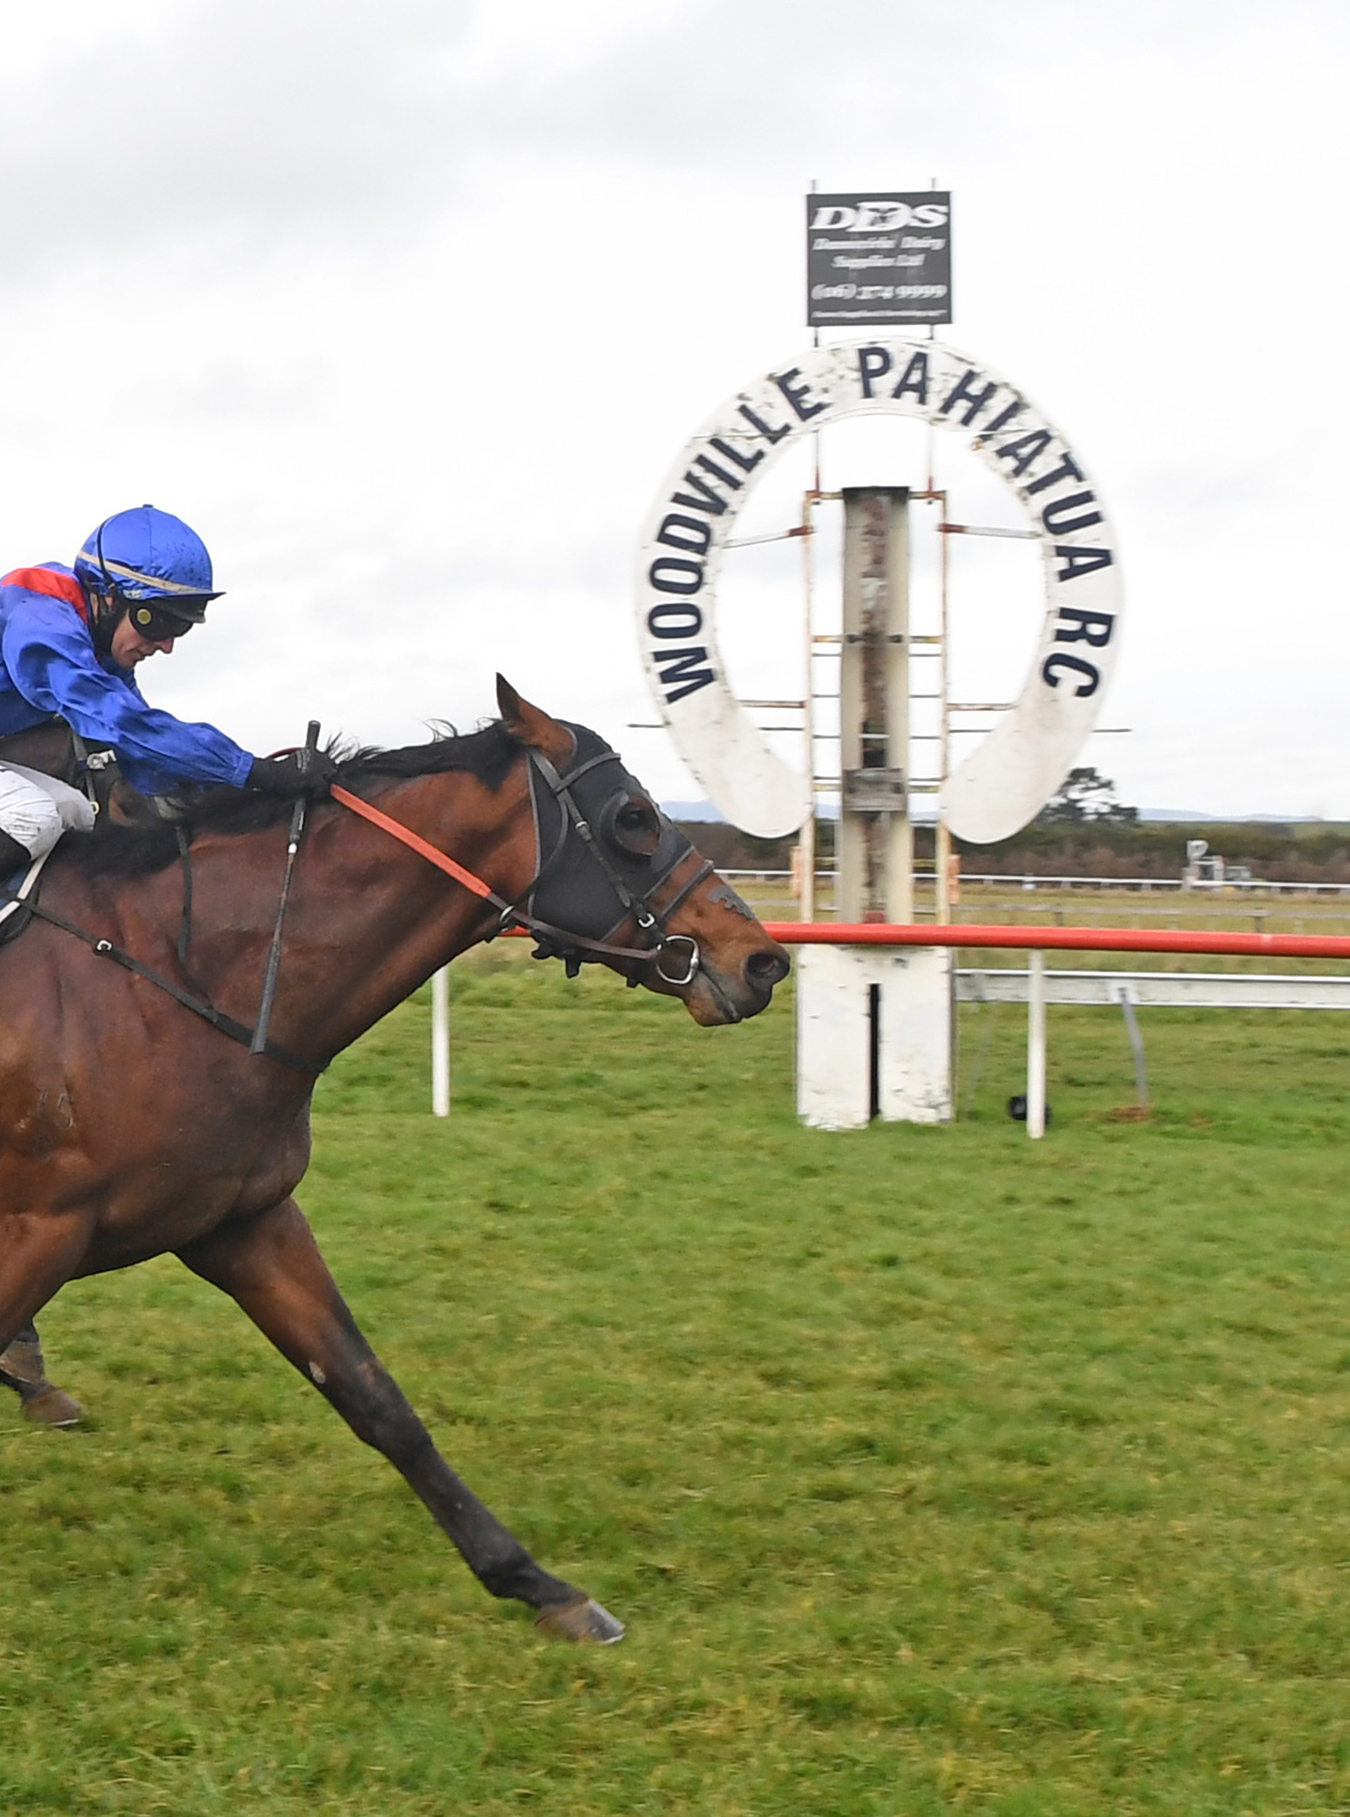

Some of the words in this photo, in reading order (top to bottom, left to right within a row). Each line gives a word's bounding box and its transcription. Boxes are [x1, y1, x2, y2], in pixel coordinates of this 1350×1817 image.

[648, 368, 832, 705] WOODVILLE
[858, 346, 1115, 583] PAHIATUA
[1043, 607, 1115, 698] RC
